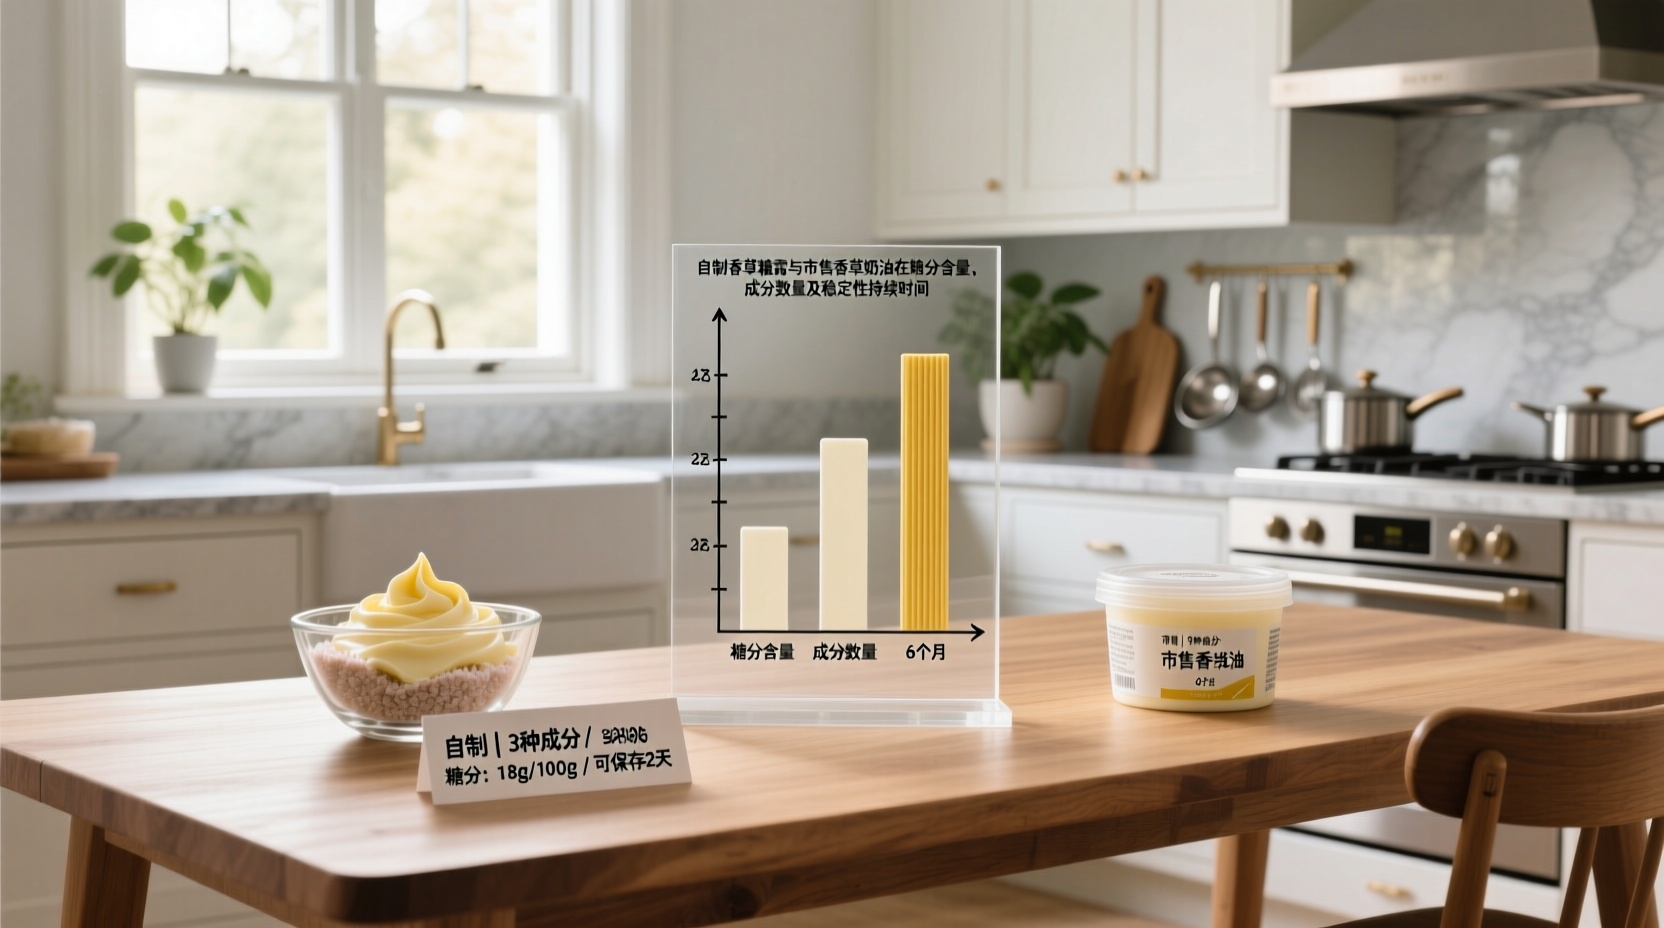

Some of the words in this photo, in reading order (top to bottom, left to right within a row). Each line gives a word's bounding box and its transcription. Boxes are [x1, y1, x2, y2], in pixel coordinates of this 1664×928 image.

[730, 643, 795, 662] 糖分含量
[812, 642, 878, 662] 成分数量
[905, 642, 945, 661] 6个月
[444, 732, 490, 761] 自制
[508, 726, 581, 754] 3种成分
[592, 749, 674, 773] 可保存2天
